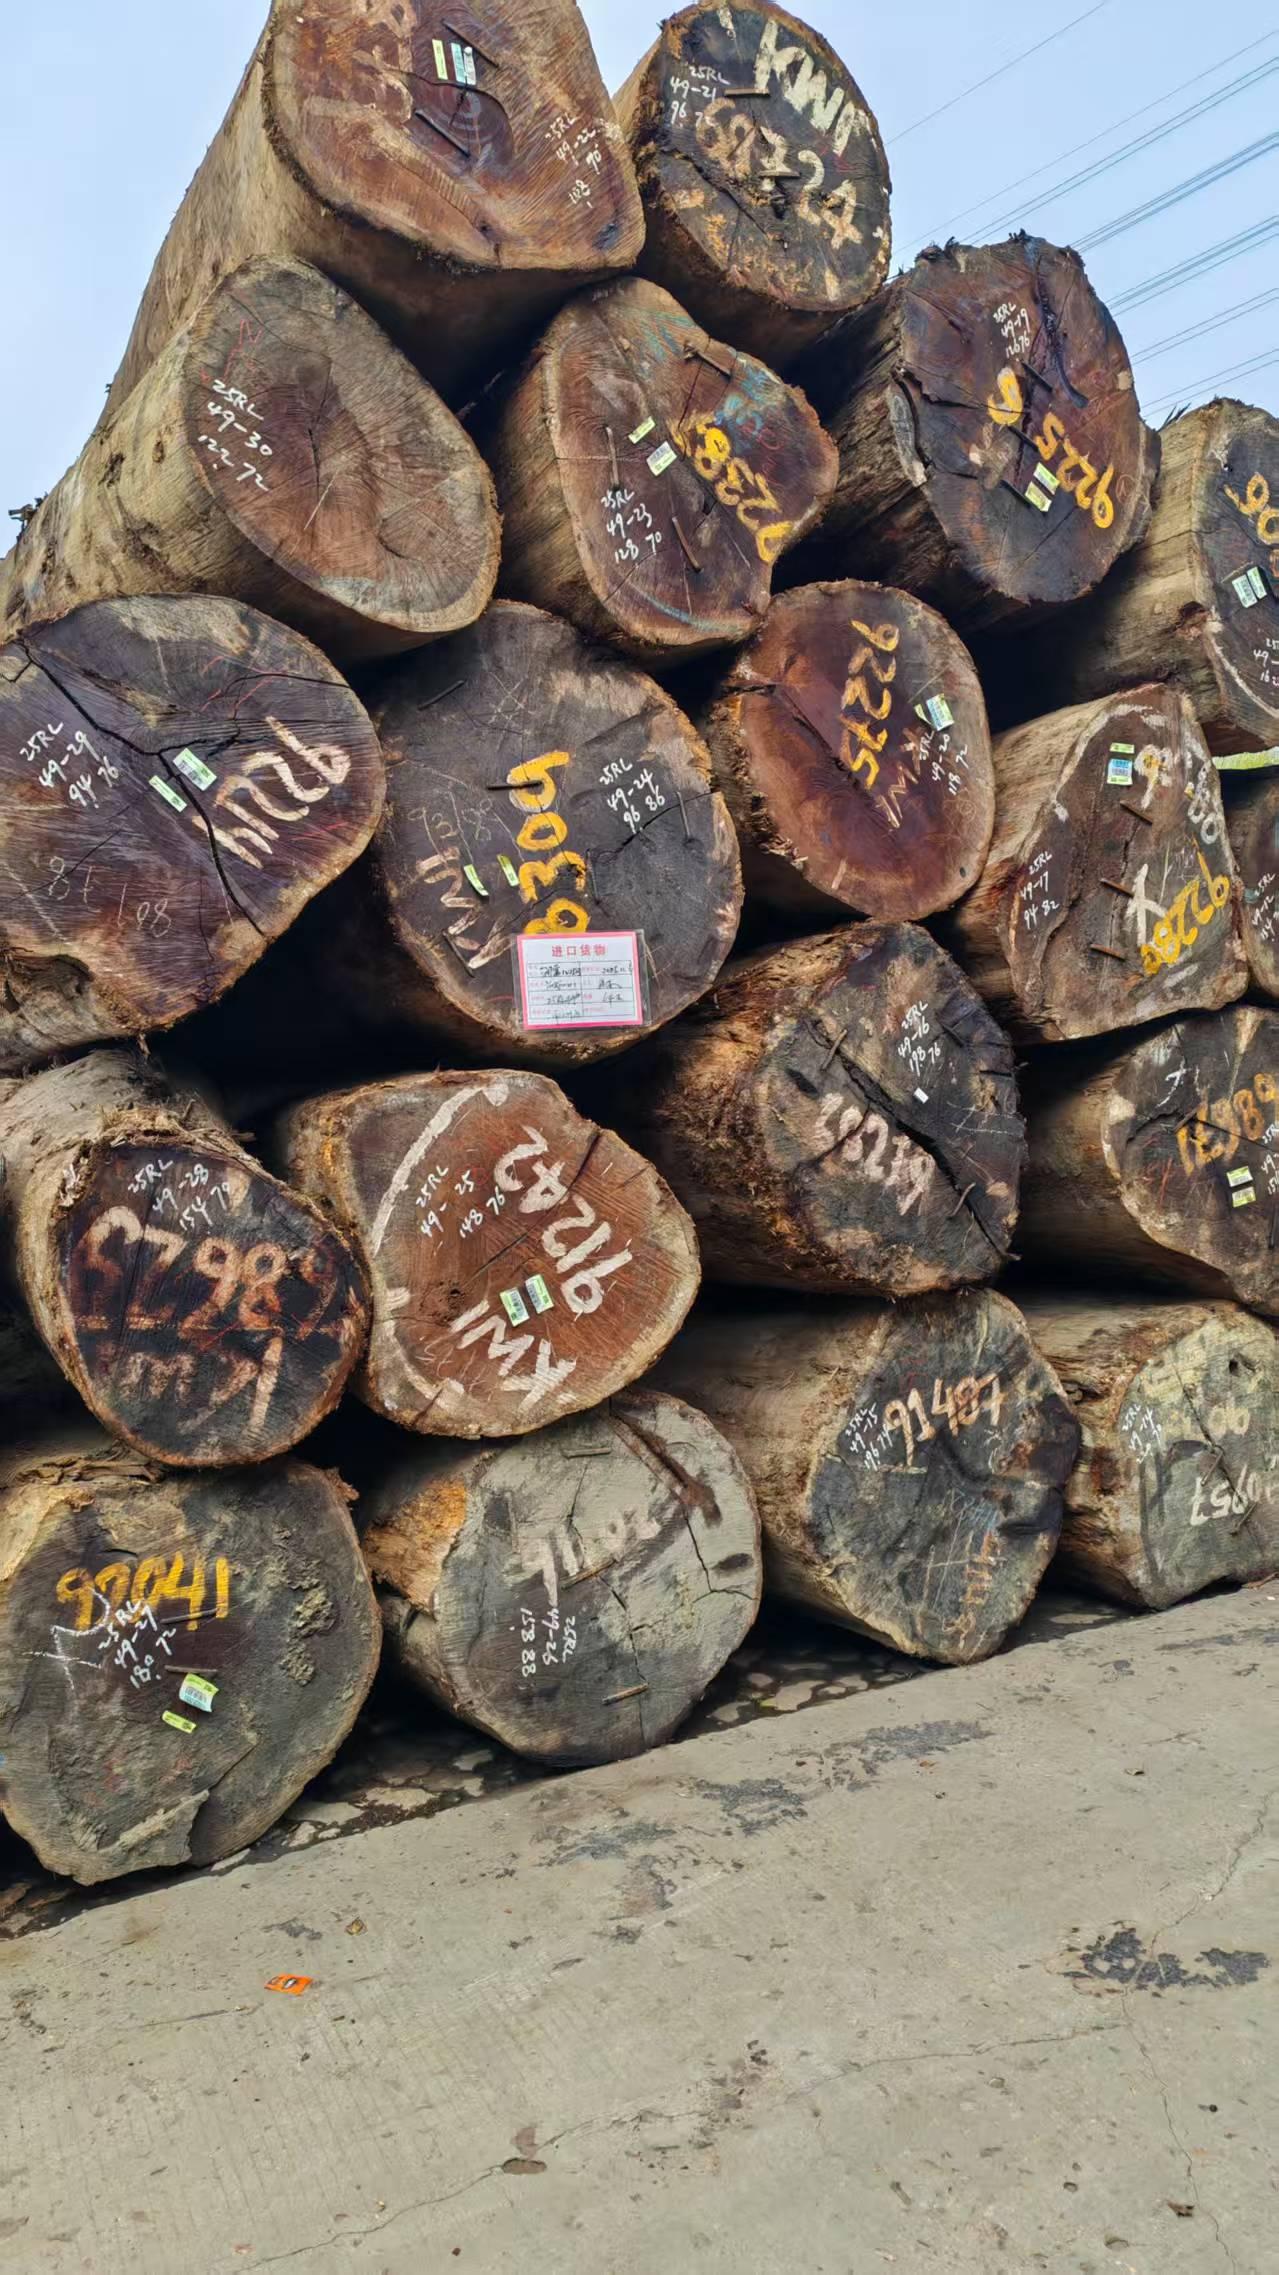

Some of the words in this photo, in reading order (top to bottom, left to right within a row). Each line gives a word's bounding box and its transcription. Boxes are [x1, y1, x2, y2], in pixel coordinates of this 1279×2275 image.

[212, 379, 264, 421] 25RL
[207, 402, 273, 455] 49-30
[20, 722, 63, 762] 25RL
[600, 758, 633, 786] 25RL
[128, 1159, 173, 1193] 25RL
[416, 1166, 448, 1207] 25RL
